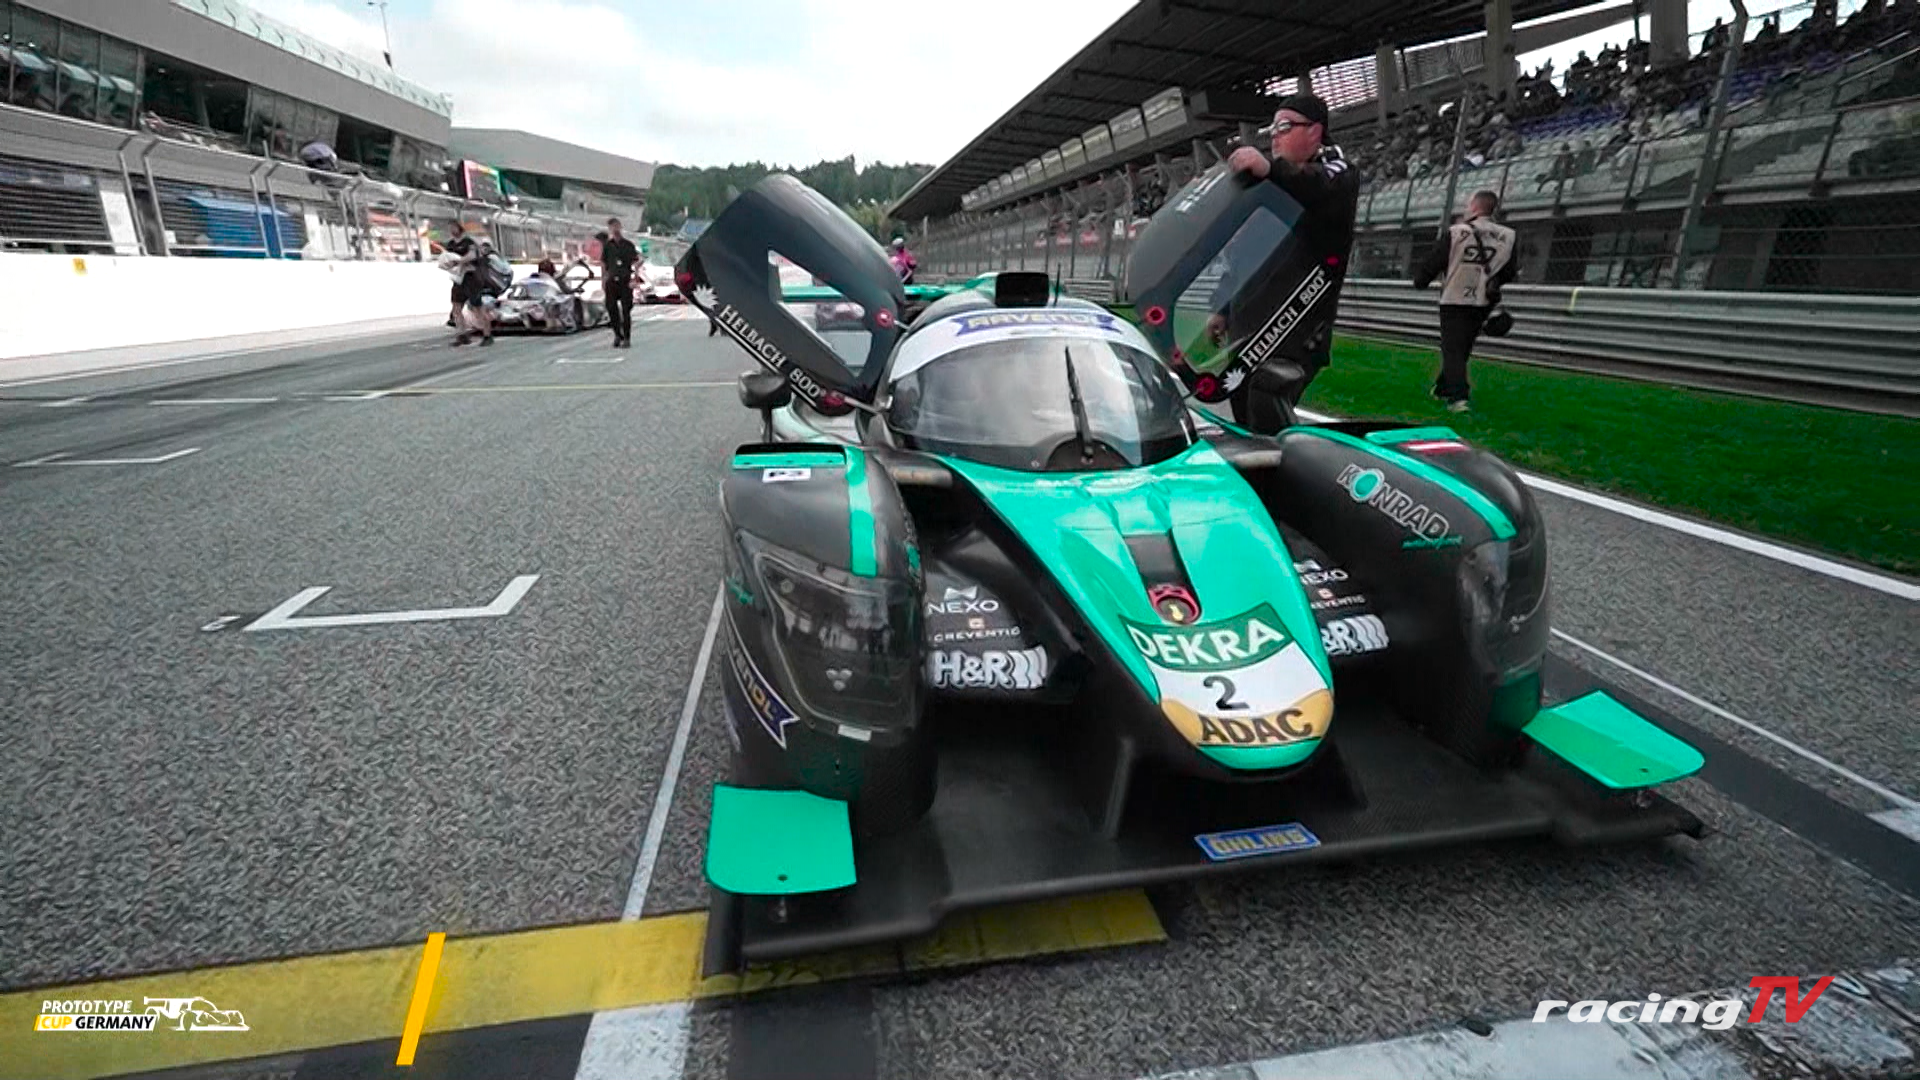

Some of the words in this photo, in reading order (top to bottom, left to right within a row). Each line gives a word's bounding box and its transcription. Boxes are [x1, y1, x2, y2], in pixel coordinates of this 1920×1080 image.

[720, 304, 787, 368] HELBACH
[967, 312, 1110, 330] RAVENOL
[1241, 306, 1298, 368] HELBACH
[1336, 462, 1450, 542] KONRAD
[927, 599, 1000, 615] NEXO
[1126, 617, 1286, 665] DEKRA
[1203, 675, 1250, 711] 2
[1198, 708, 1314, 743] ADAC
